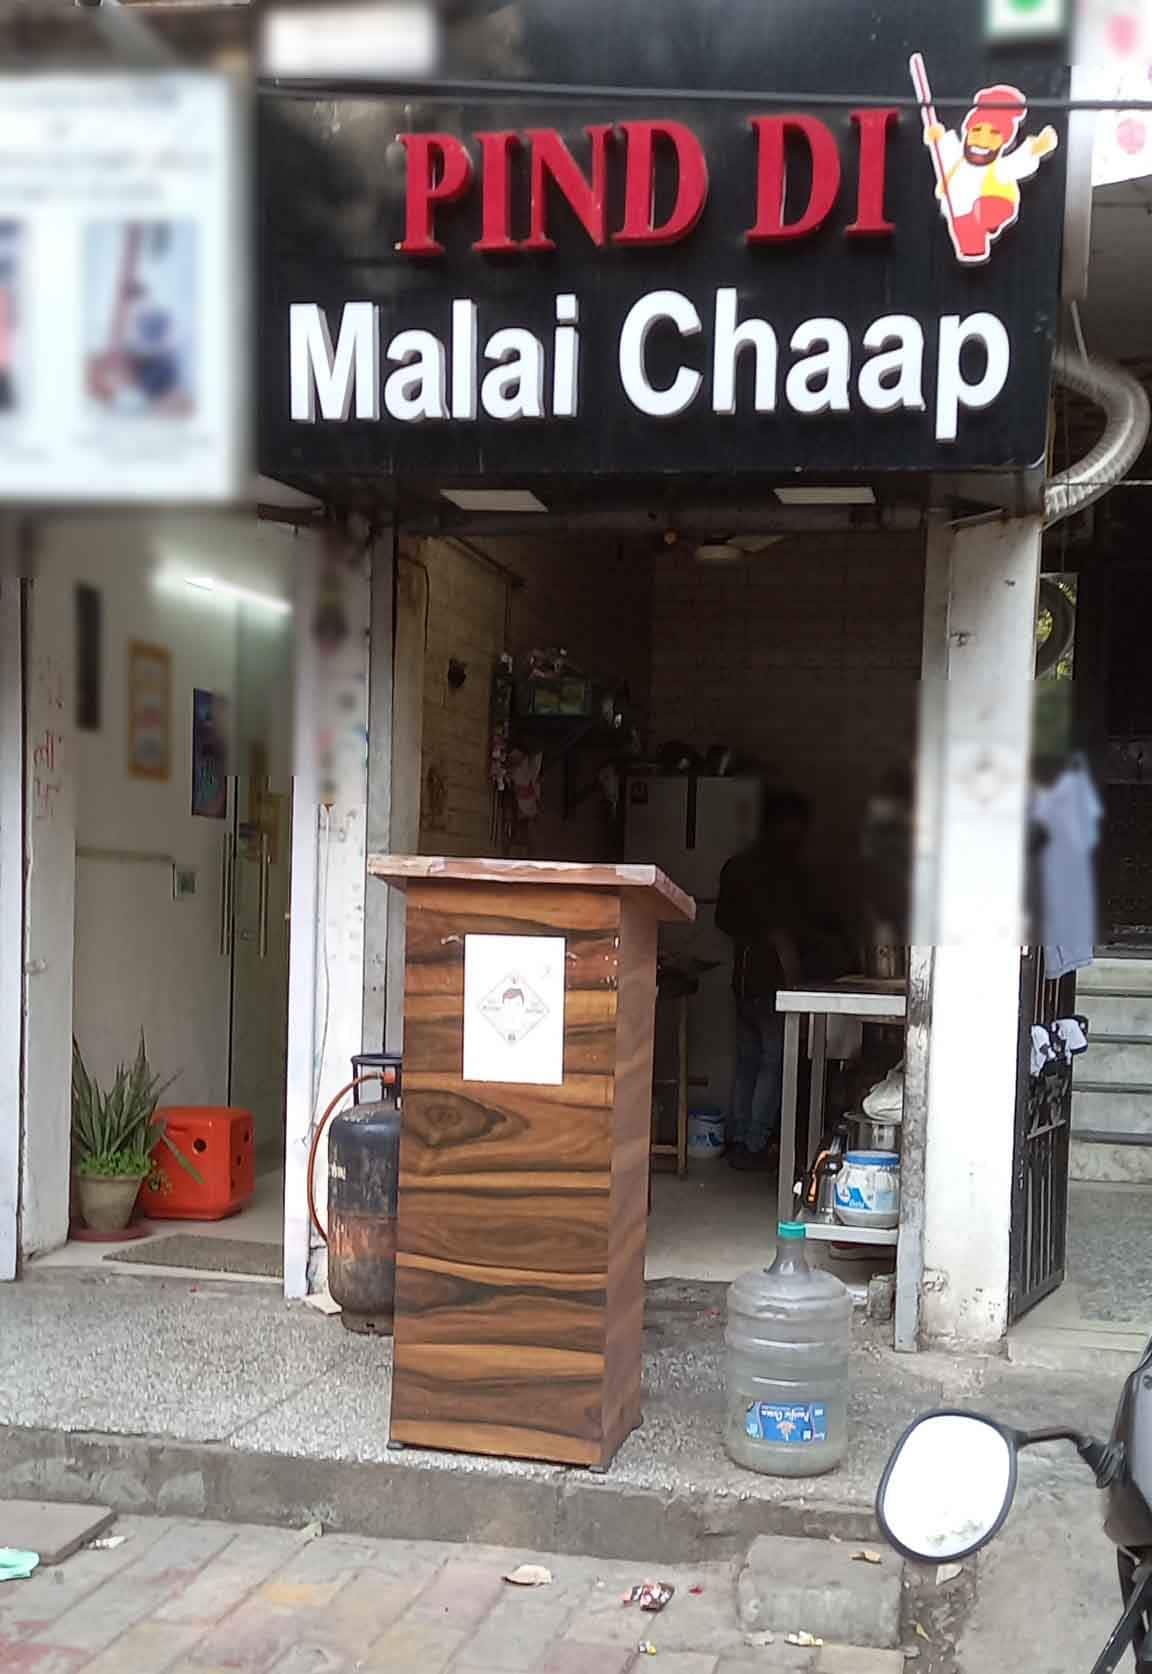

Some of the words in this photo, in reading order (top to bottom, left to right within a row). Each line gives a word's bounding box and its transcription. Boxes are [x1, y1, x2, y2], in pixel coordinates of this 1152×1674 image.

[396, 119, 709, 254] PIND
[746, 107, 902, 243] DI
[289, 293, 580, 424] Malai
[619, 287, 1011, 442] Chaap
